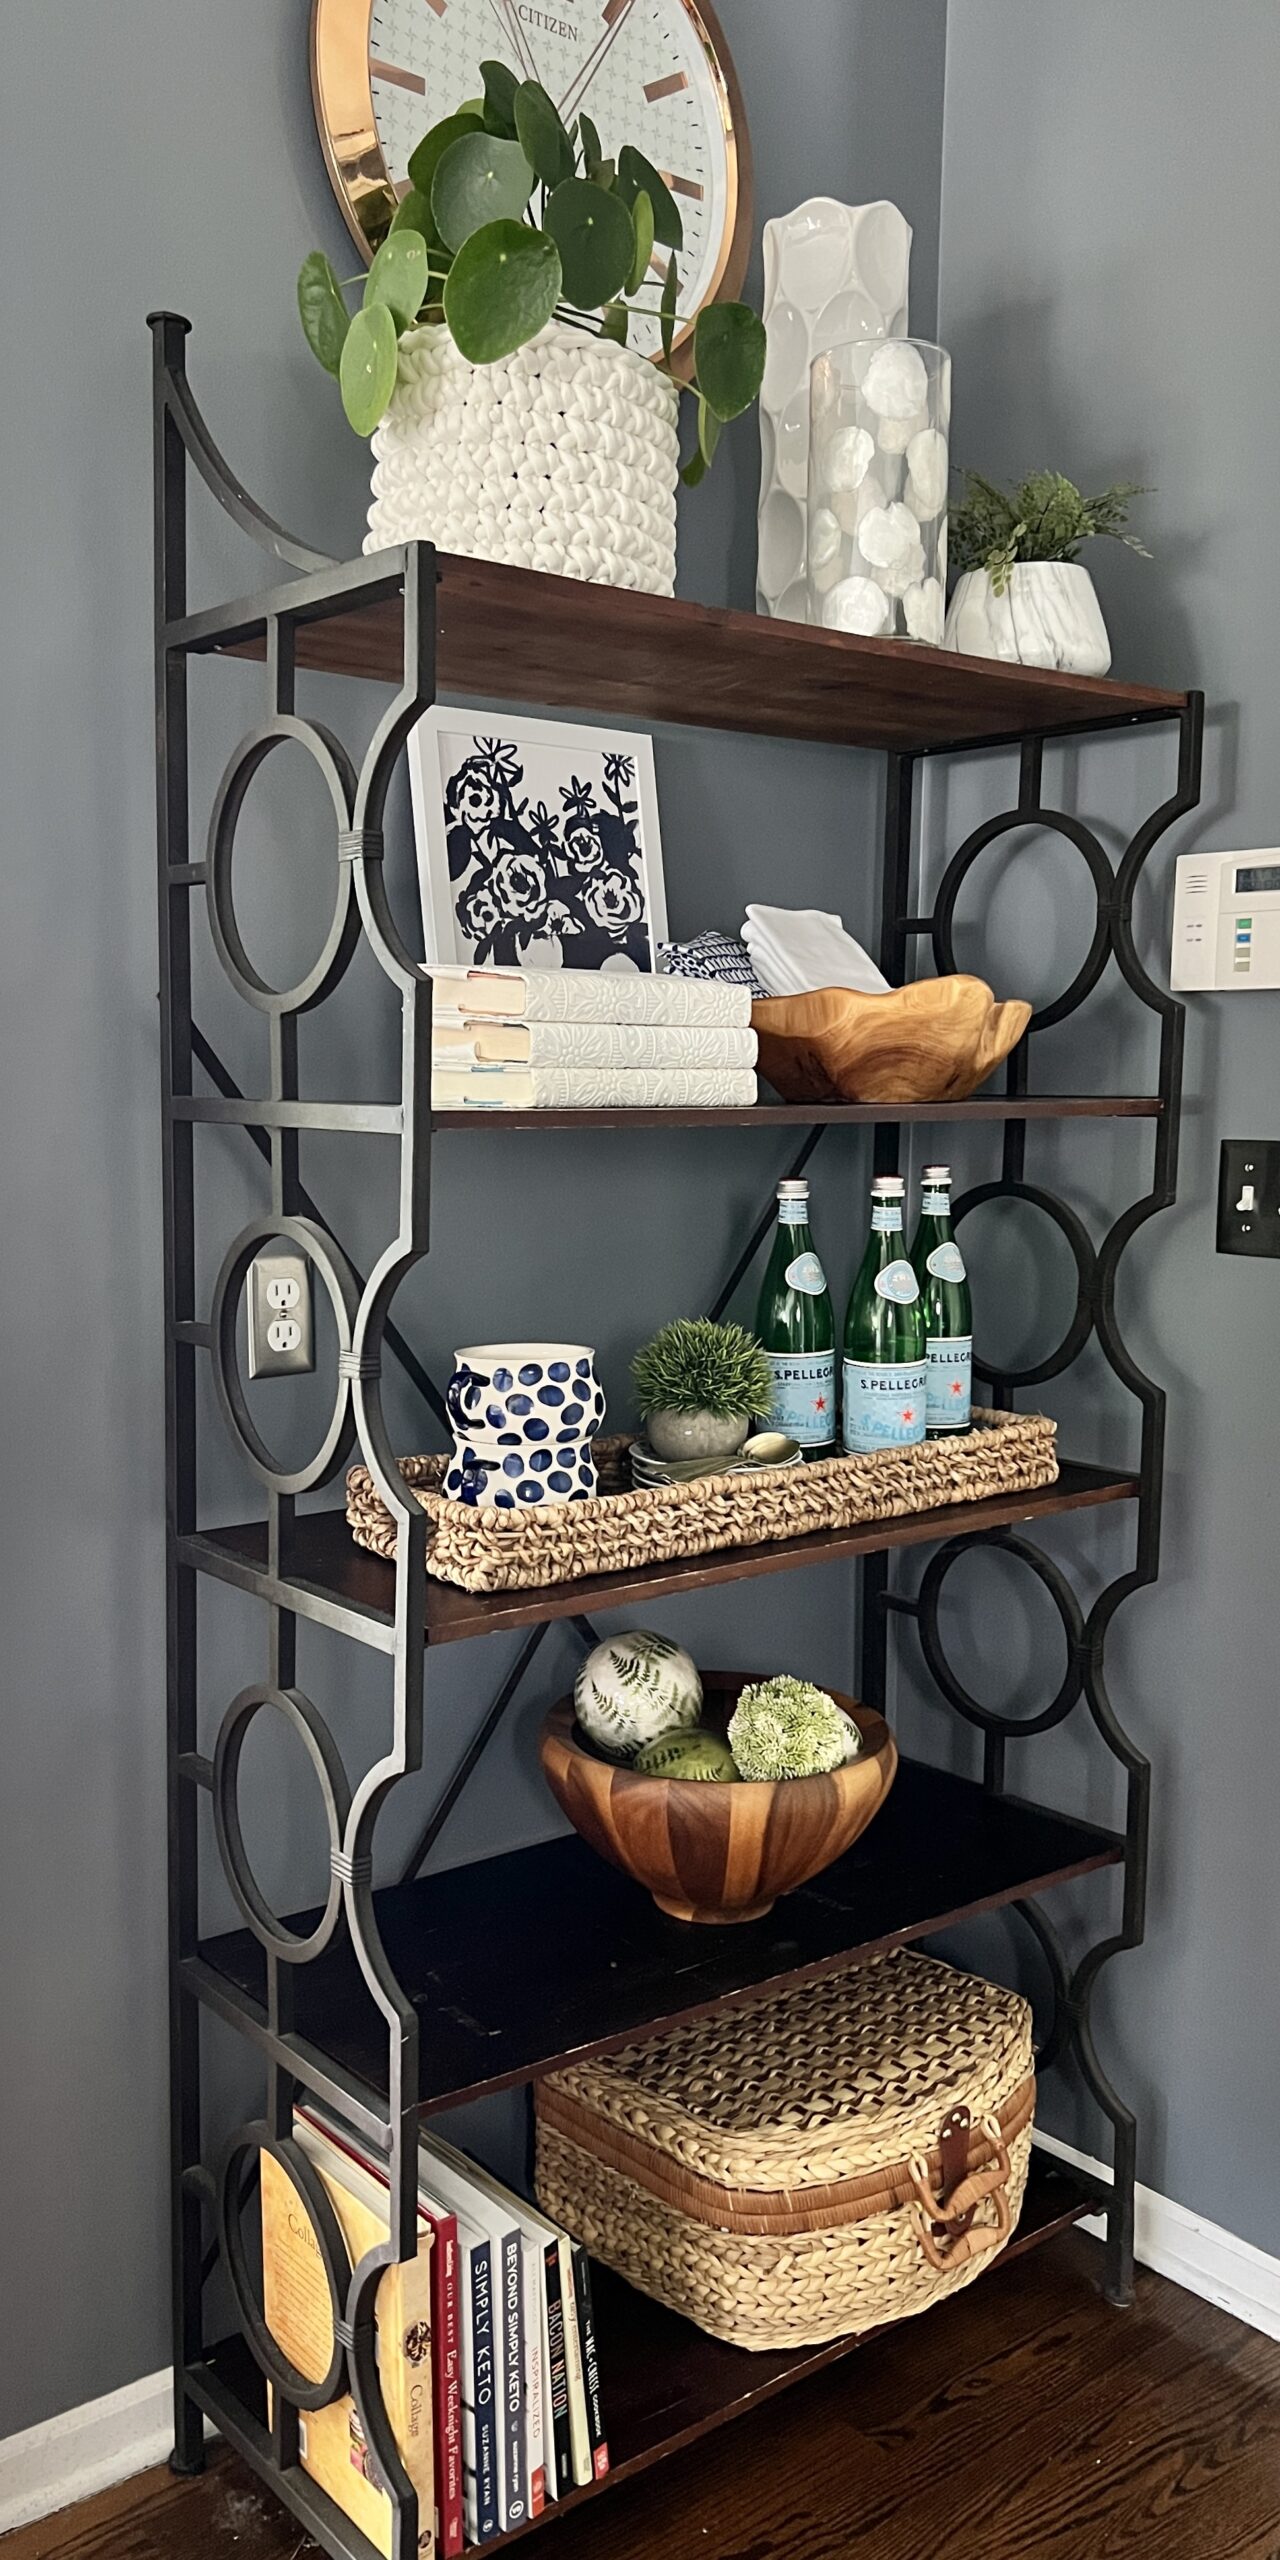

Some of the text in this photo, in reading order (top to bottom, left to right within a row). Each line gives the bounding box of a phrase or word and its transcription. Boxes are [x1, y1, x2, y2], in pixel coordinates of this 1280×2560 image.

[518, 4, 578, 42] CITIZEN
[475, 2260, 492, 2405] SIMPLY KETO
[506, 2242, 520, 2412] BEYOND SIMPLY KETO
[548, 2299, 568, 2420] BACON NATION
[585, 2336, 596, 2360] MAC
[444, 2349, 457, 2379] Easy
[531, 2346, 540, 2439] INSPIRALIZED
[445, 2380, 459, 2443] Weeknight
[448, 2446, 460, 2500] Favorites
[482, 2424, 491, 2506] SUZANNE RYAN
